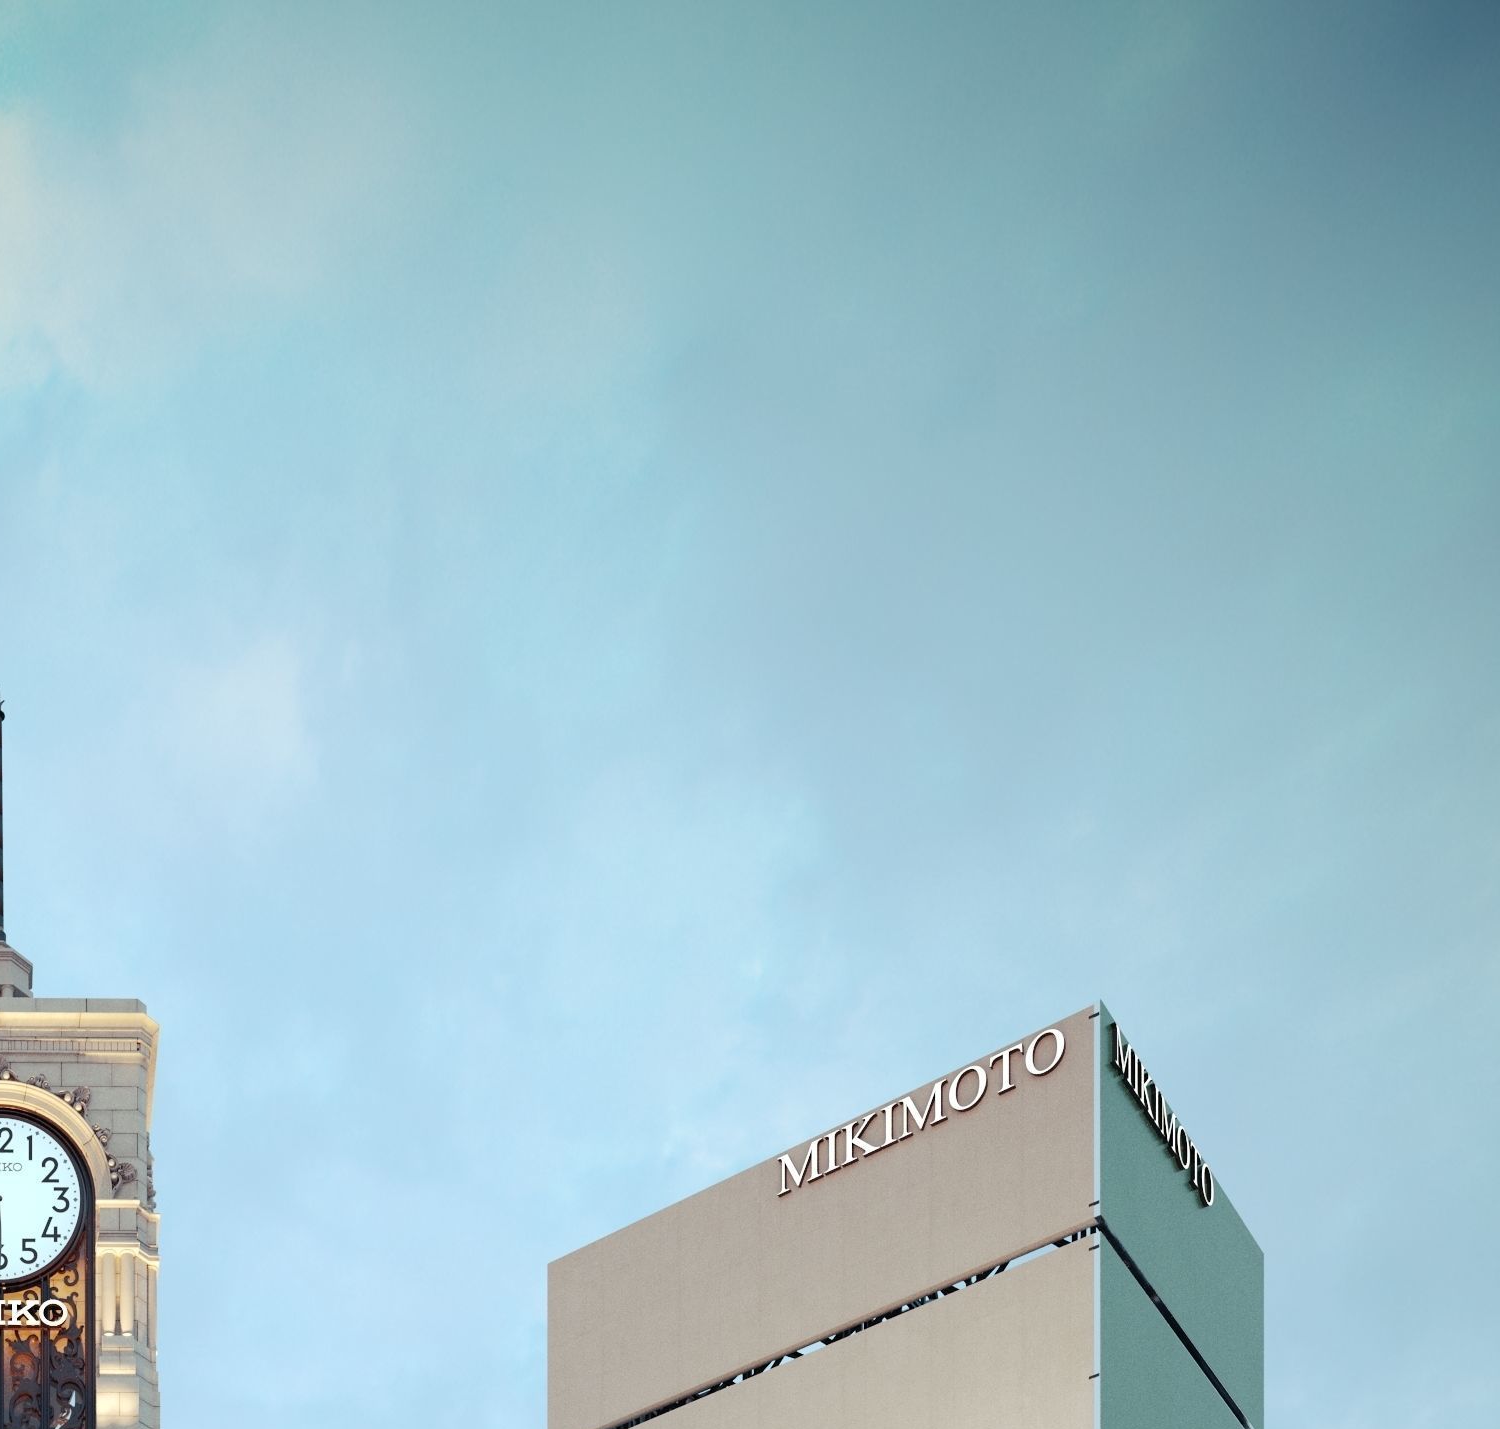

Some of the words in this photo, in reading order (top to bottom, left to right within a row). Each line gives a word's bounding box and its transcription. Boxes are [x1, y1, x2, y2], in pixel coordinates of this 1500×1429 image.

[777, 1028, 1066, 1197] MIKIMOTO
[1113, 1021, 1215, 1207] MIKIMOTO
[26, 1135, 33, 1161] 1
[41, 1157, 60, 1183] 2
[52, 1187, 70, 1213] 3
[41, 1217, 61, 1242] 4
[19, 1238, 38, 1264] 5
